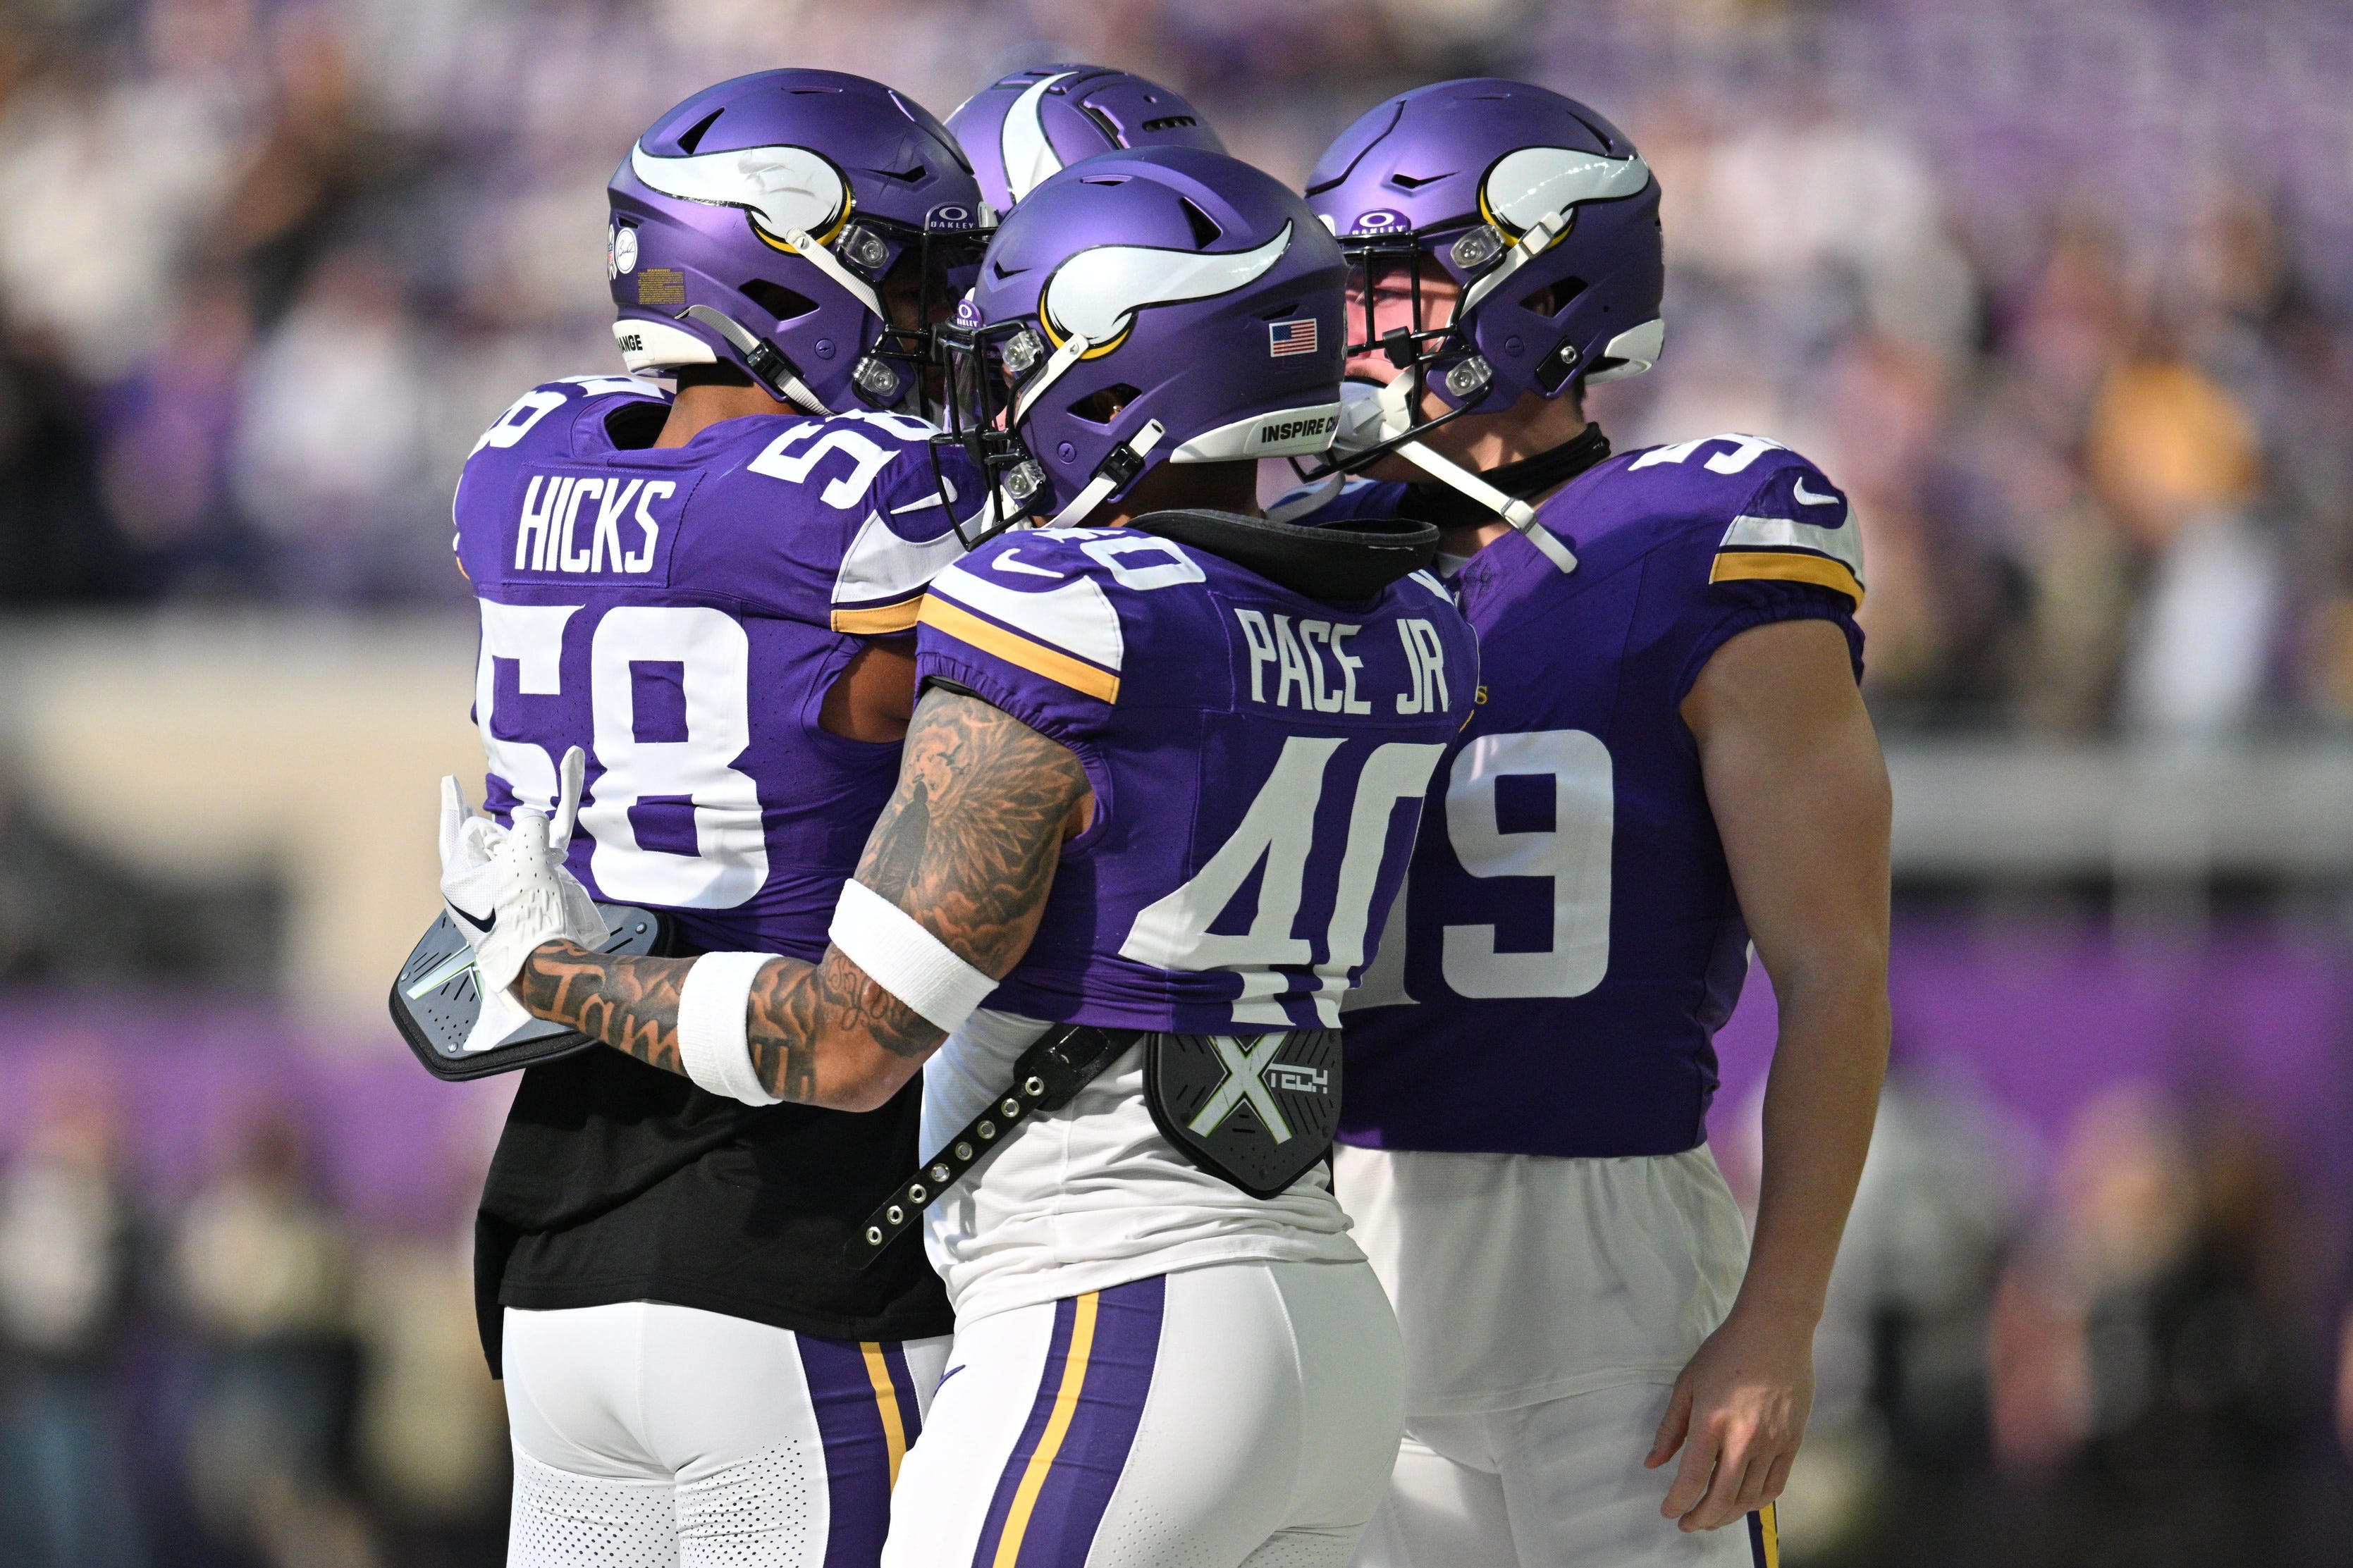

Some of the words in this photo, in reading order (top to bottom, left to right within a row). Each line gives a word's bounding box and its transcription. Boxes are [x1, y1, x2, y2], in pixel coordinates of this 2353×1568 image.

[618, 334, 643, 353] ANGE
[1262, 418, 1325, 443] INSPIRE
[515, 475, 677, 574] HICKS
[1234, 608, 1371, 715] PACE
[1396, 618, 1449, 715] JR
[1118, 736, 1447, 1029] 40
